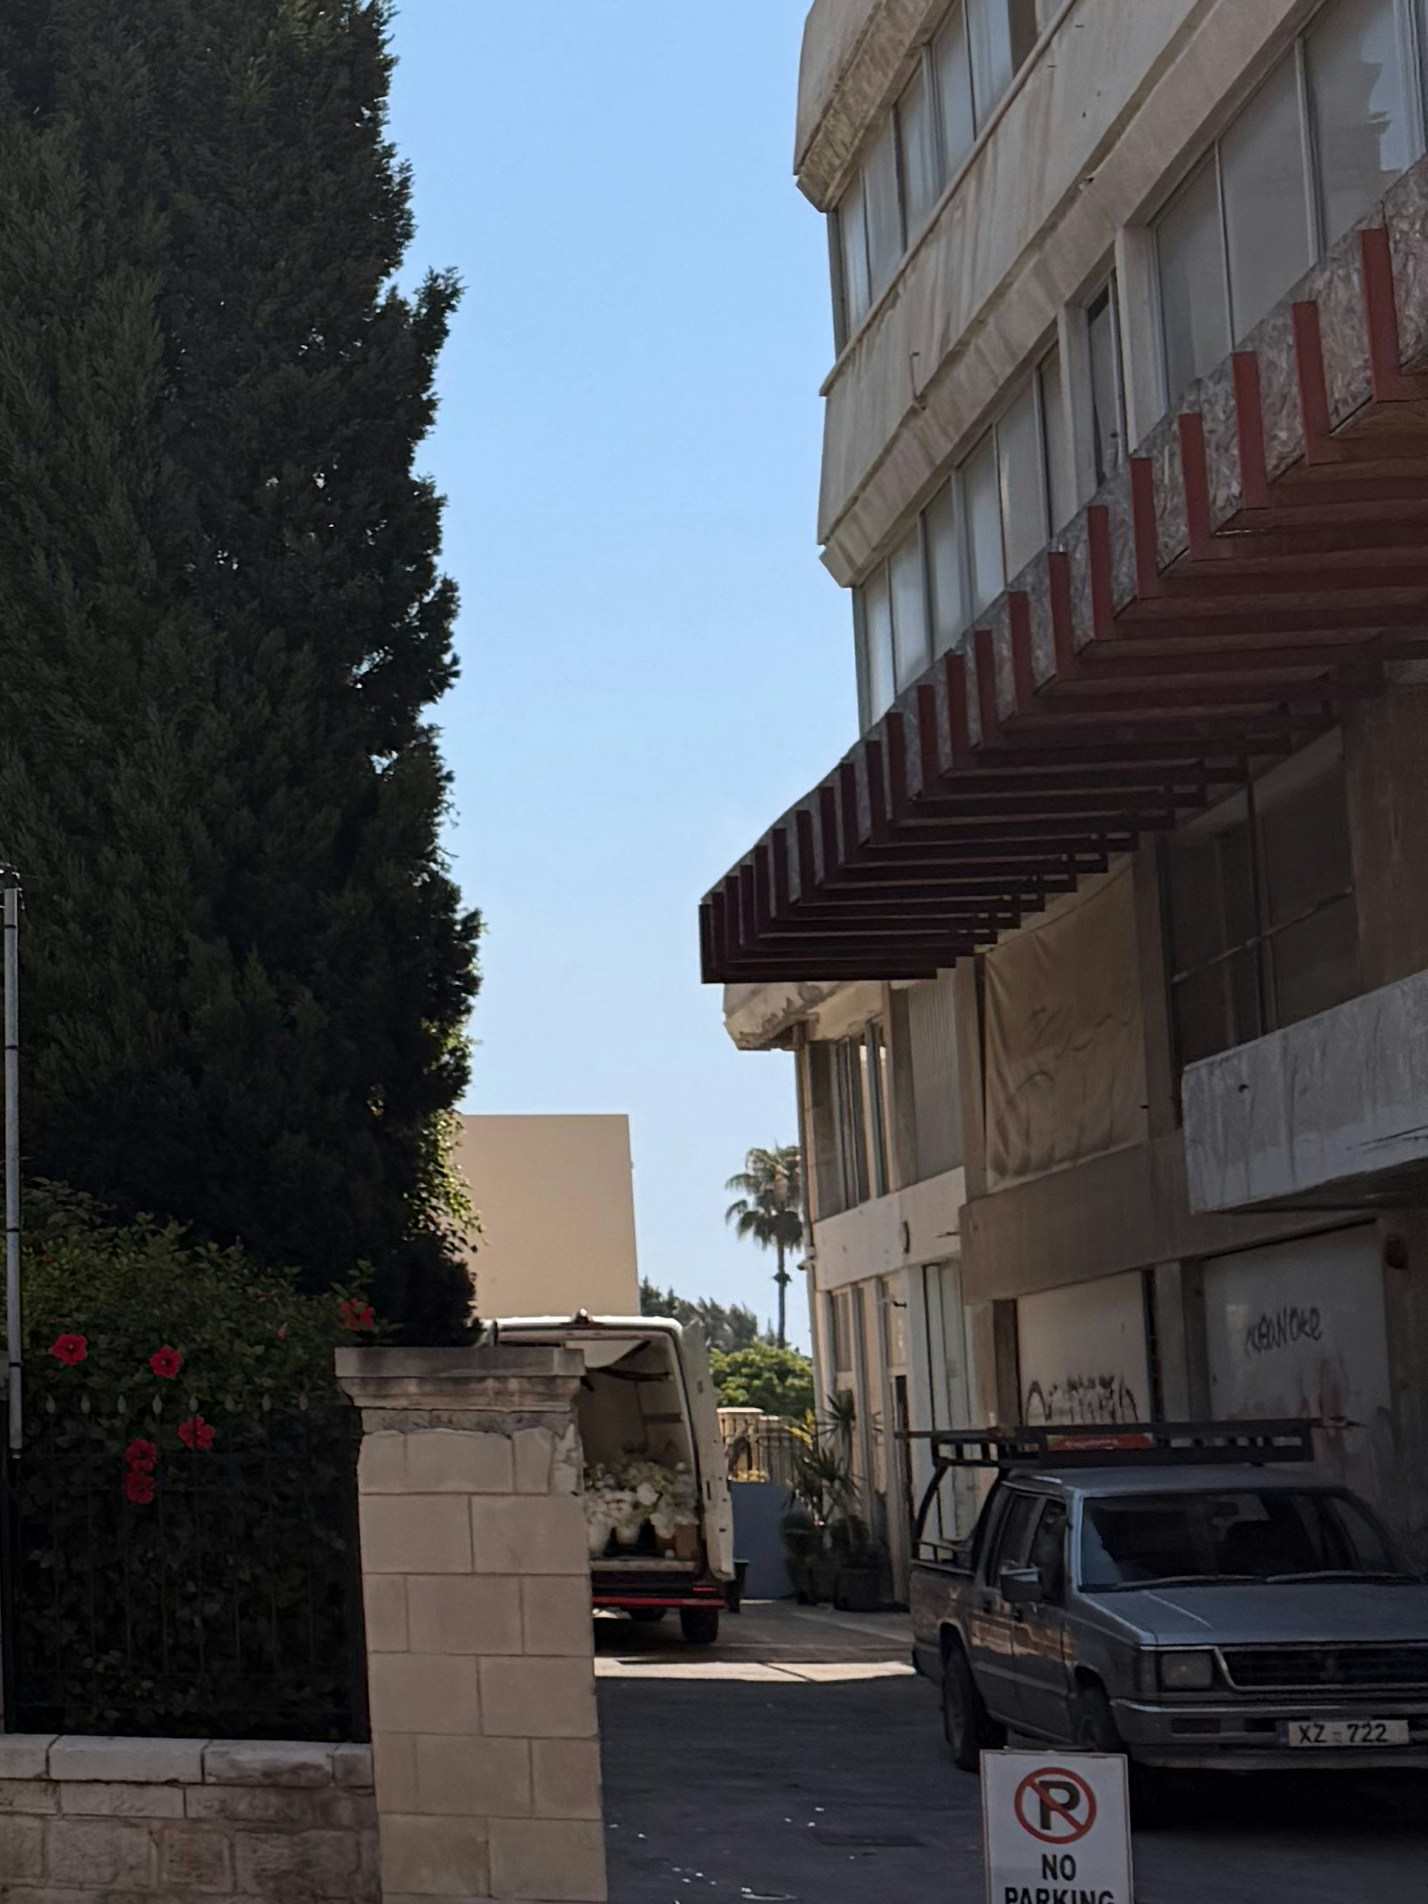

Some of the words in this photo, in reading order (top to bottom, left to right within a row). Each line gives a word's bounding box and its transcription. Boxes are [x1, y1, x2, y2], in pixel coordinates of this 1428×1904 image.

[1299, 1723, 1327, 1744] XZ
[1347, 1723, 1389, 1743] 722
[1041, 1854, 1076, 1881] NO
